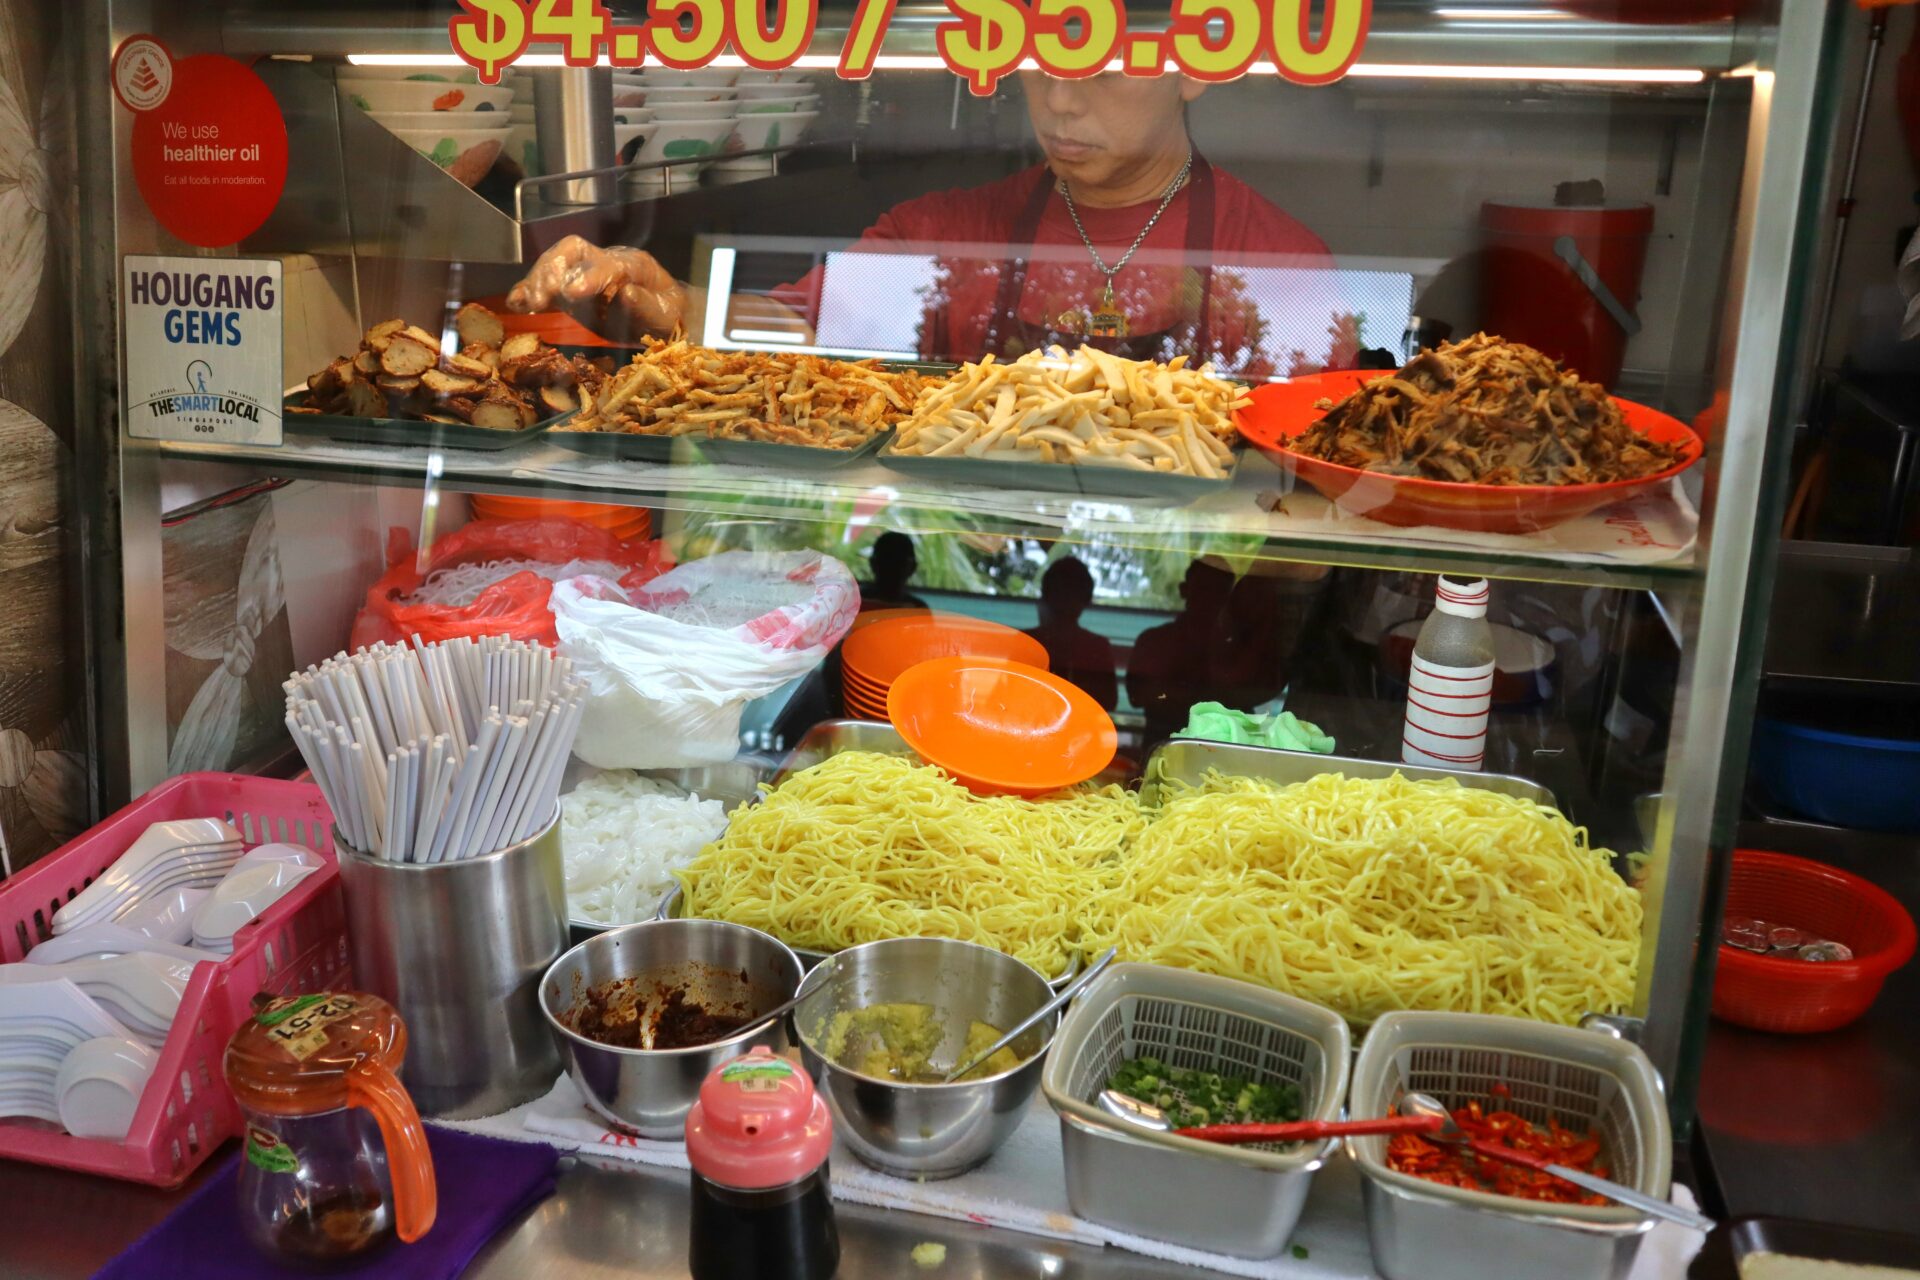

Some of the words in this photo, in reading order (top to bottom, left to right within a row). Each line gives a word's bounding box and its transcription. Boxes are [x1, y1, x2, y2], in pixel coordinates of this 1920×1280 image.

[162, 122, 187, 139] We
[191, 125, 219, 139] use
[164, 145, 236, 161] healthier
[240, 144, 260, 161] oil
[164, 175, 177, 185] Eat
[179, 175, 187, 185] all
[189, 175, 210, 185] foods
[212, 175, 220, 185] in
[221, 175, 266, 185] moderation.
[131, 271, 275, 310] HOUGANG
[164, 309, 241, 346] GEMS
[149, 395, 259, 423] THESMARTLOCAL
